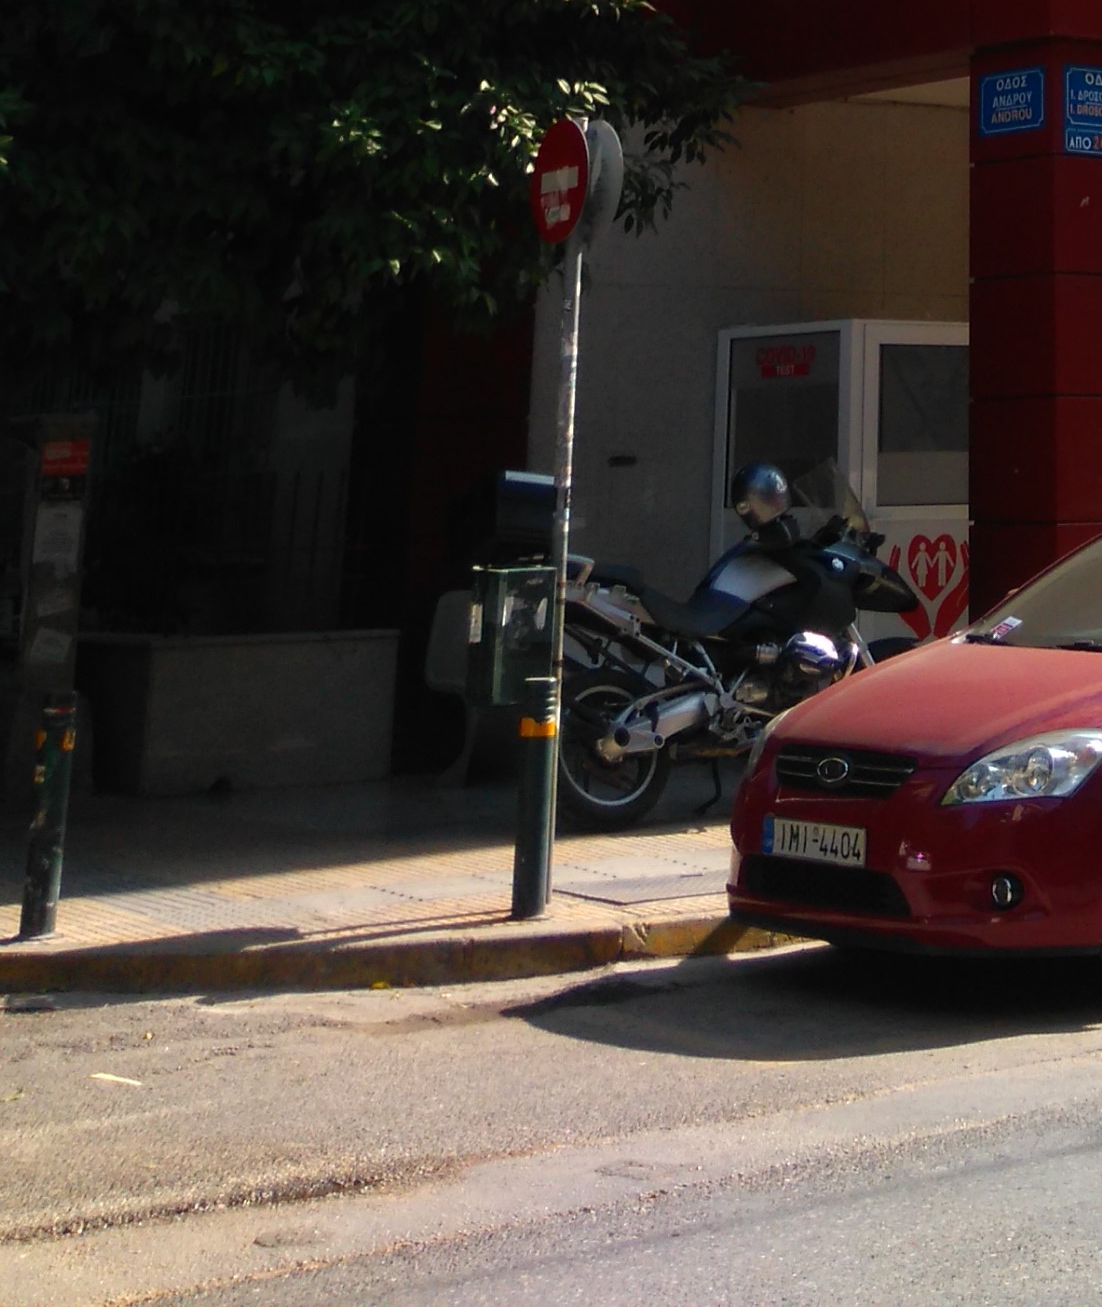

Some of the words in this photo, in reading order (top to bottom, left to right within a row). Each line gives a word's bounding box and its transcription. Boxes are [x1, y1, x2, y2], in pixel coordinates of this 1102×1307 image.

[996, 75, 1028, 91] ΟΔΟΣ
[992, 91, 1032, 108] ΑΝΔΡΟΥ
[991, 108, 1032, 123] ANDROU
[1069, 136, 1092, 150] ΑΠΟ
[776, 365, 796, 376] TEST
